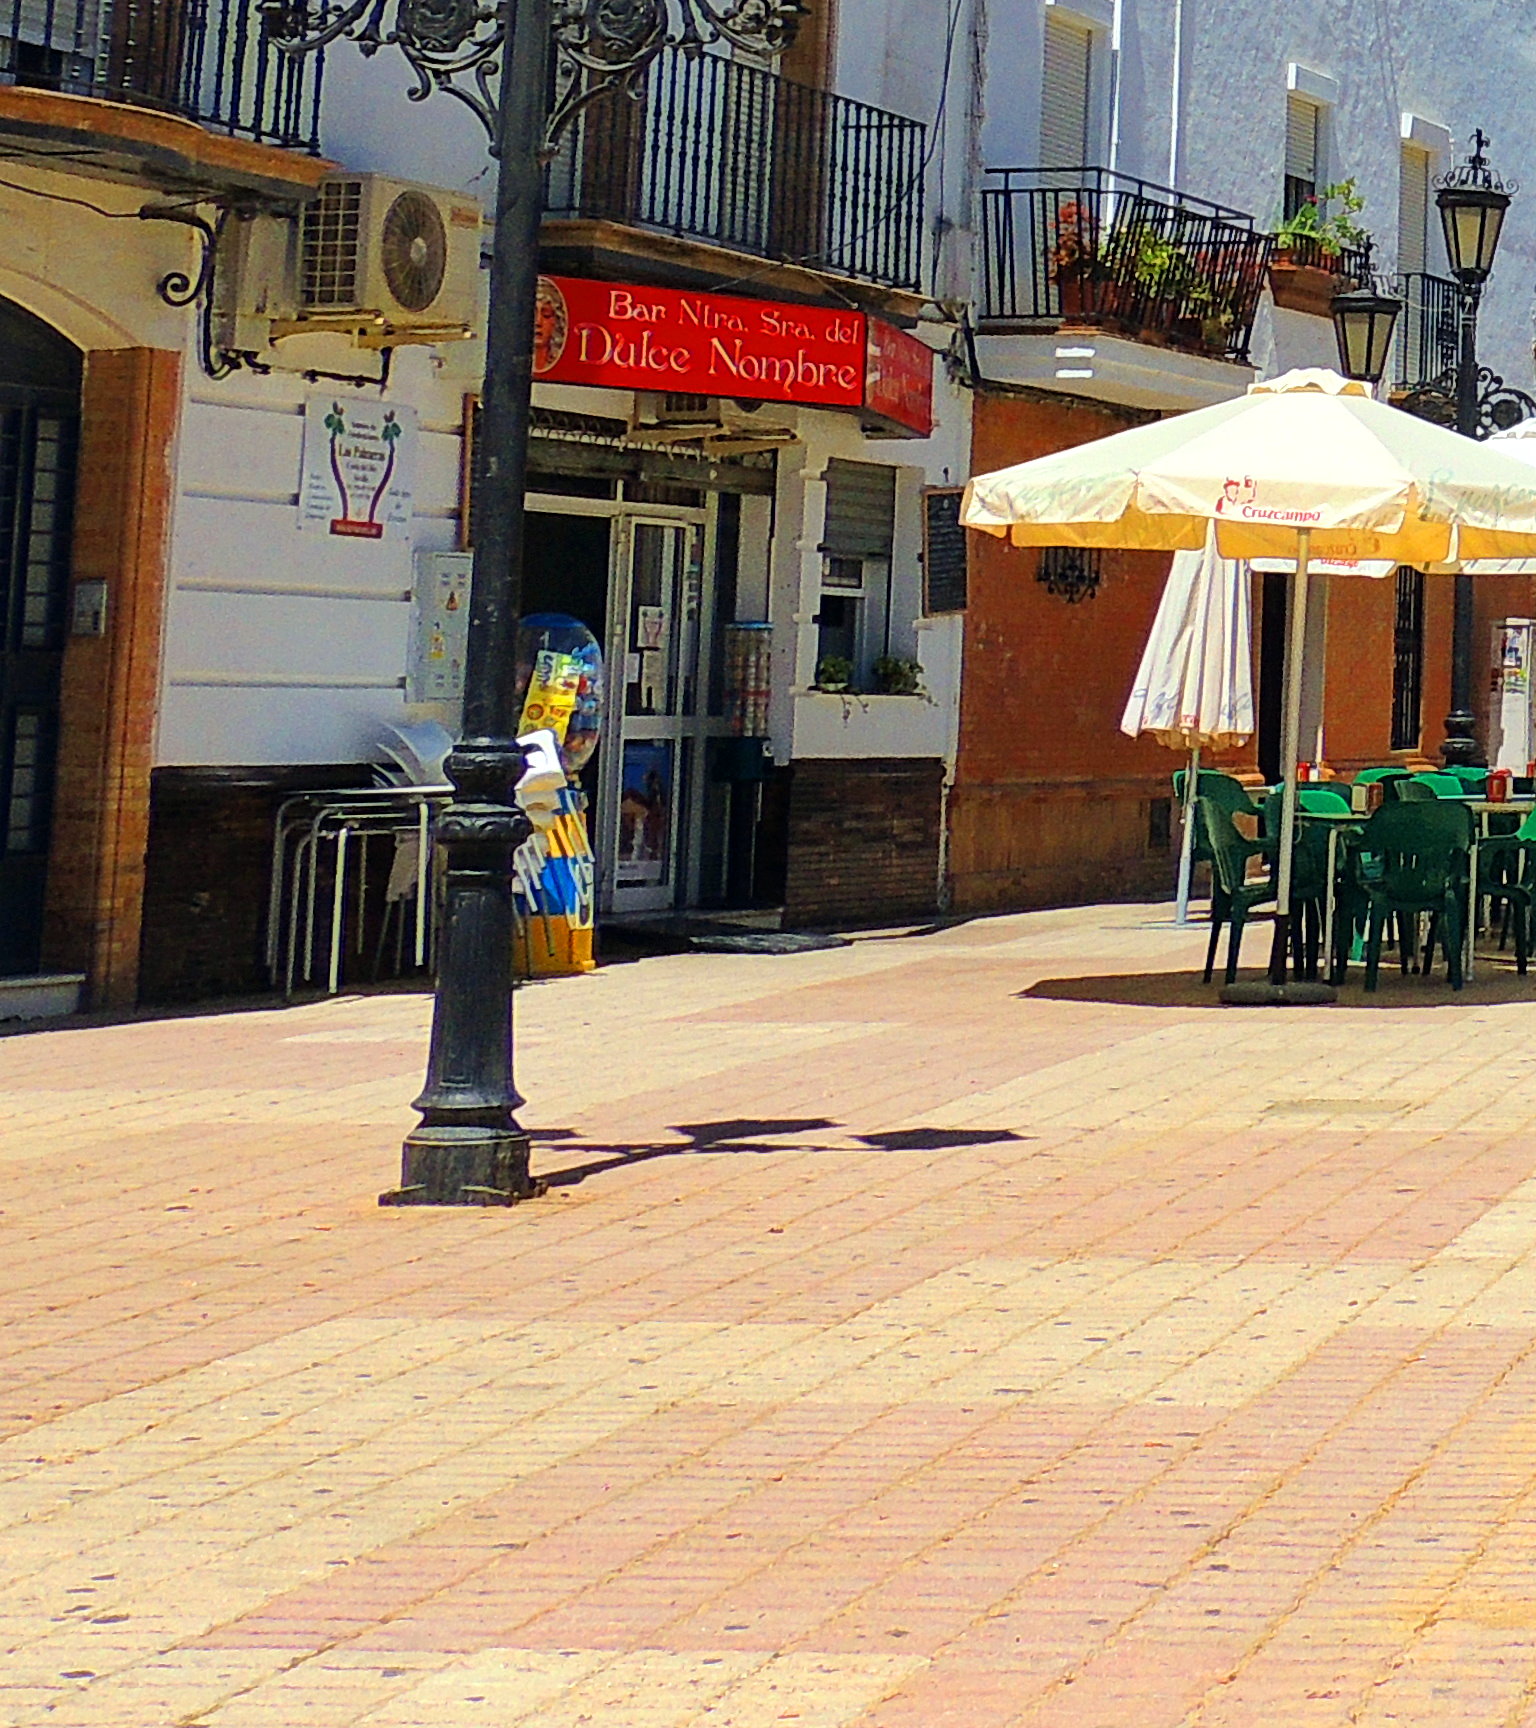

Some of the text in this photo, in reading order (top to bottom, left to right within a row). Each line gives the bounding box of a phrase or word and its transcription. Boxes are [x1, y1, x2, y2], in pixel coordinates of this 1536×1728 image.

[608, 290, 860, 345] Bar Ntra. Sra. del
[574, 322, 691, 373] Dulce
[709, 337, 858, 396] Nombre
[1241, 505, 1322, 523] Cruzcampo
